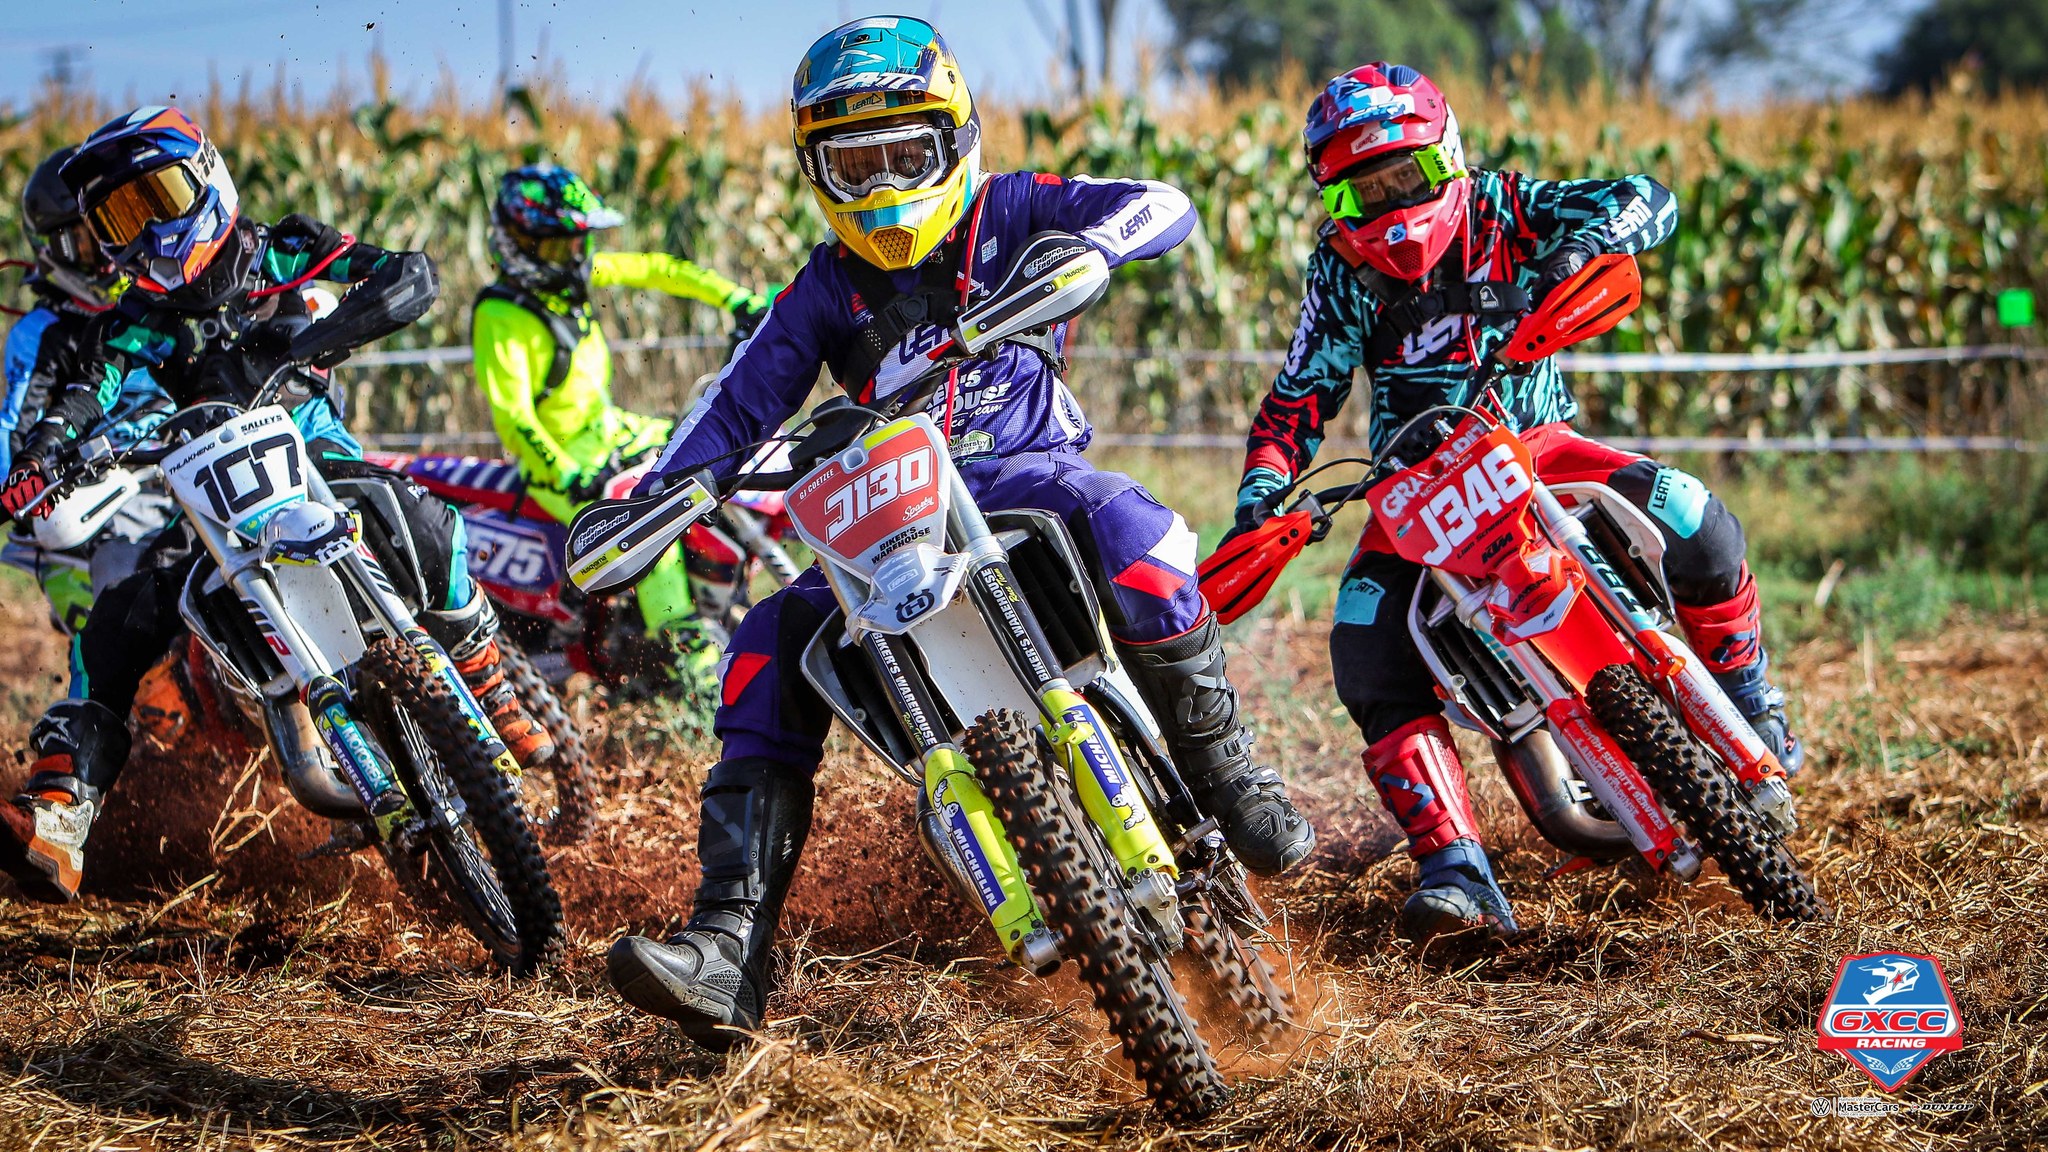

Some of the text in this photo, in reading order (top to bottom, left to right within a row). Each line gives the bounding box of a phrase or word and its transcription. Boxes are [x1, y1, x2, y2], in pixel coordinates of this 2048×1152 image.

[1119, 204, 1153, 241] LEATT
[1033, 247, 1063, 267] Enduro
[1037, 246, 1087, 272] Engineering
[240, 414, 283, 432] SALLEYS
[193, 432, 302, 524] 107
[808, 468, 834, 492] COETZEE
[825, 446, 932, 544] J130
[1652, 474, 1671, 509] LEATT
[1418, 443, 1532, 566] J346
[579, 520, 607, 542] Enduro
[582, 510, 630, 548] Engineering
[871, 527, 931, 565] WAREHOUSE
[879, 526, 917, 551] BIKER'S
[1481, 532, 1514, 564] KTM
[581, 554, 607, 575] Husqvarna
[981, 567, 1050, 682] BIKER'S WAREHOUSE
[872, 632, 938, 746] BIKER'S WAREHOUSE
[331, 741, 372, 801] MICHELIN
[340, 724, 388, 789] MOTOREX
[1599, 749, 1637, 794] SECURITY
[953, 827, 998, 907] MICHELIN
